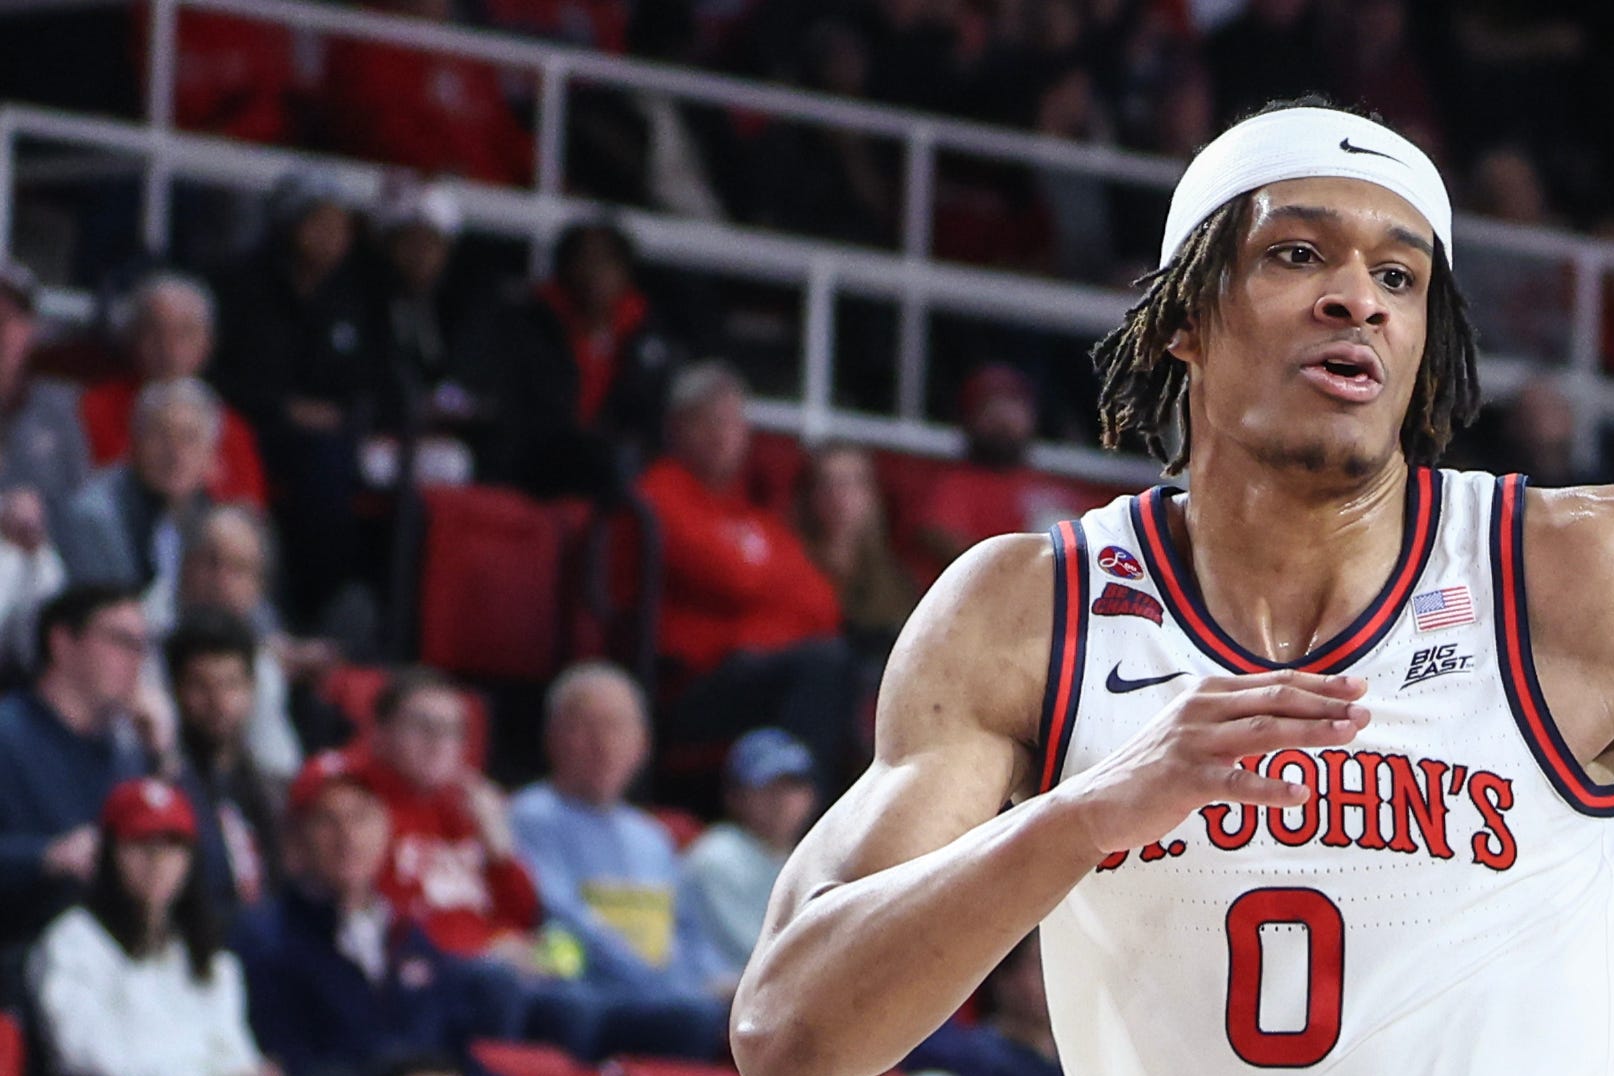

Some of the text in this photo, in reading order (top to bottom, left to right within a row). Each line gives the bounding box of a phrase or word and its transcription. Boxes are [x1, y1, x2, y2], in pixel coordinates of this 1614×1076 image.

[1404, 655, 1475, 681] EAST
[1410, 643, 1458, 667] BIG
[1200, 748, 1518, 872] JOHN'S
[1225, 887, 1345, 1068] 0
